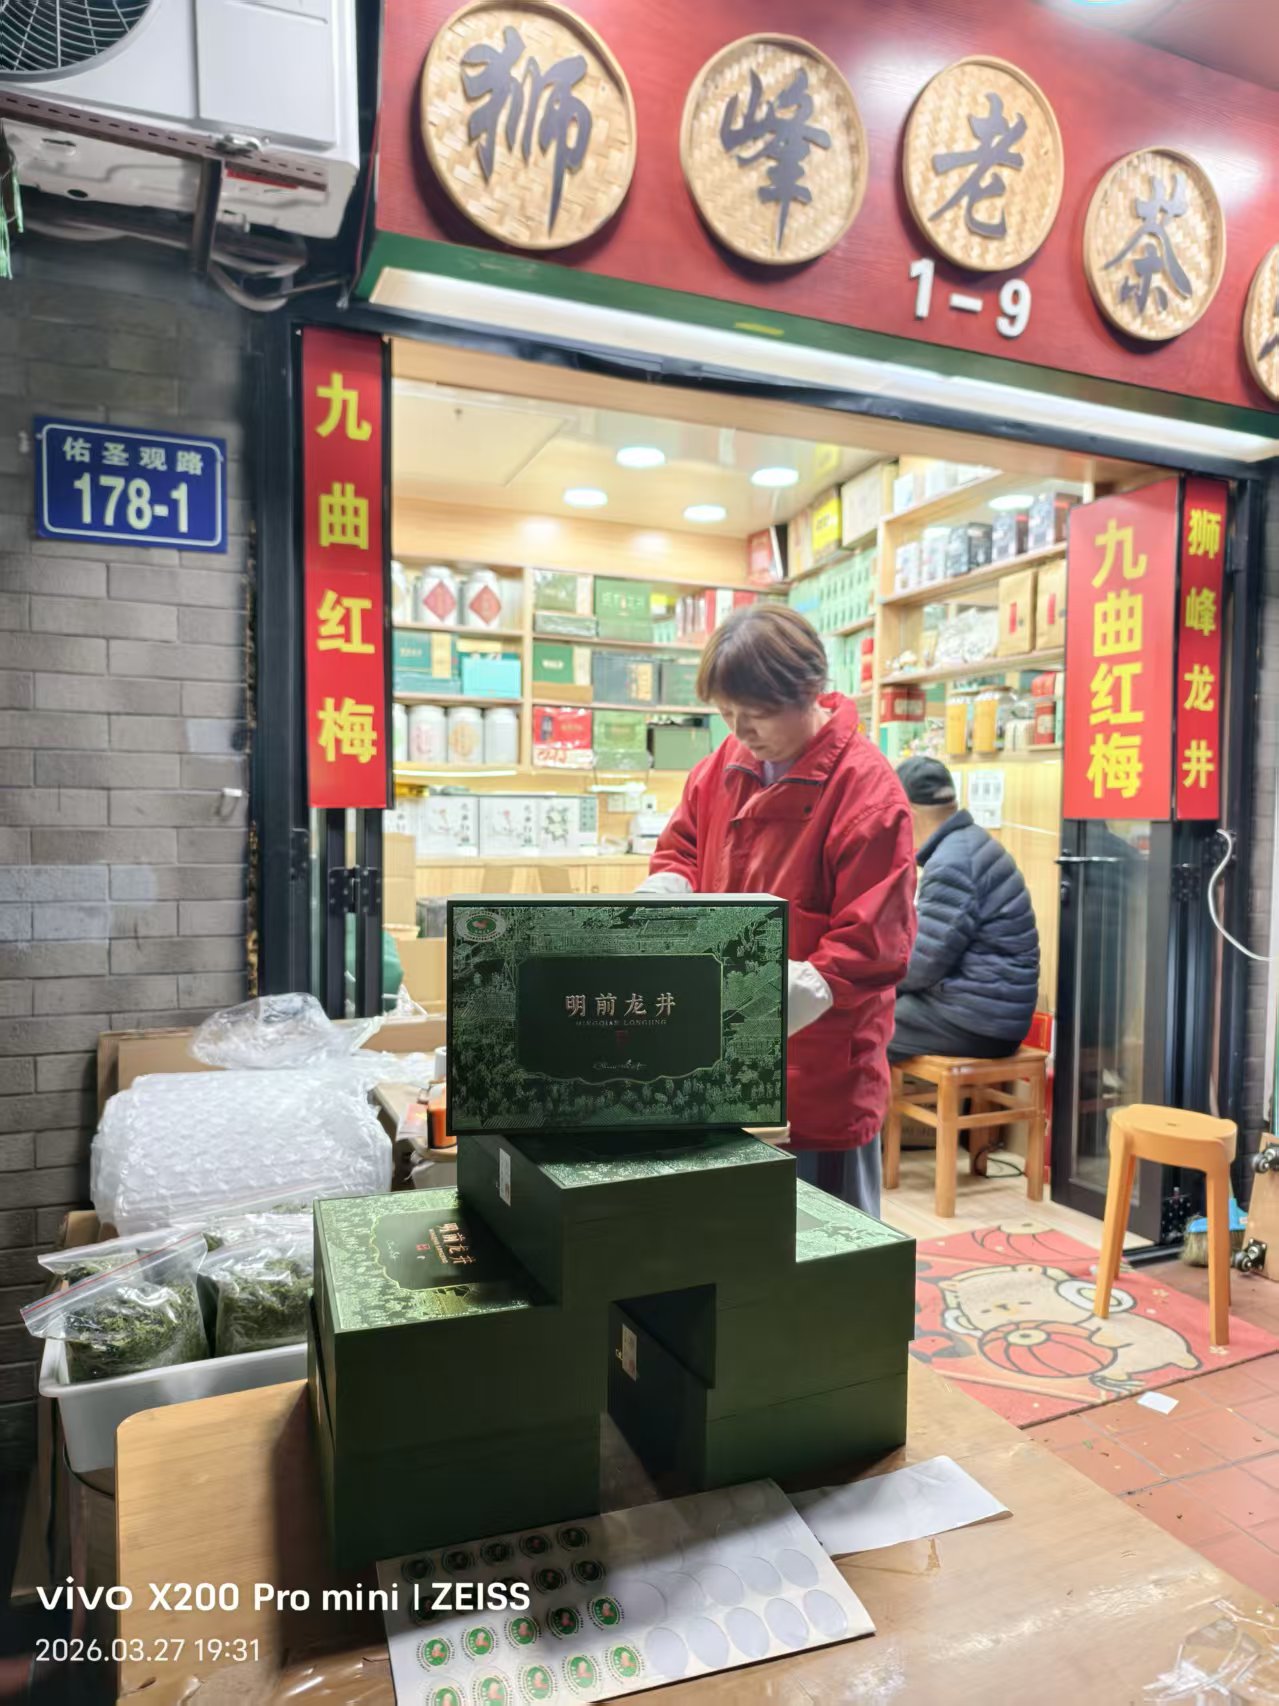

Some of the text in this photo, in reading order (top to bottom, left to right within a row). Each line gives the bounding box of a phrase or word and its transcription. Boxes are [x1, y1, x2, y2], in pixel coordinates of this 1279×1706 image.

[460, 26, 1279, 362] 狮峰老茶
[909, 258, 1032, 338] 1-9
[62, 436, 205, 477] 佑圣观路
[73, 472, 190, 534] 178-1
[316, 372, 377, 764] 九曲红梅
[1086, 517, 1147, 799] 九曲红梅
[1182, 508, 1222, 789] 狮峰龙井
[565, 992, 676, 1017] 明前龙井
